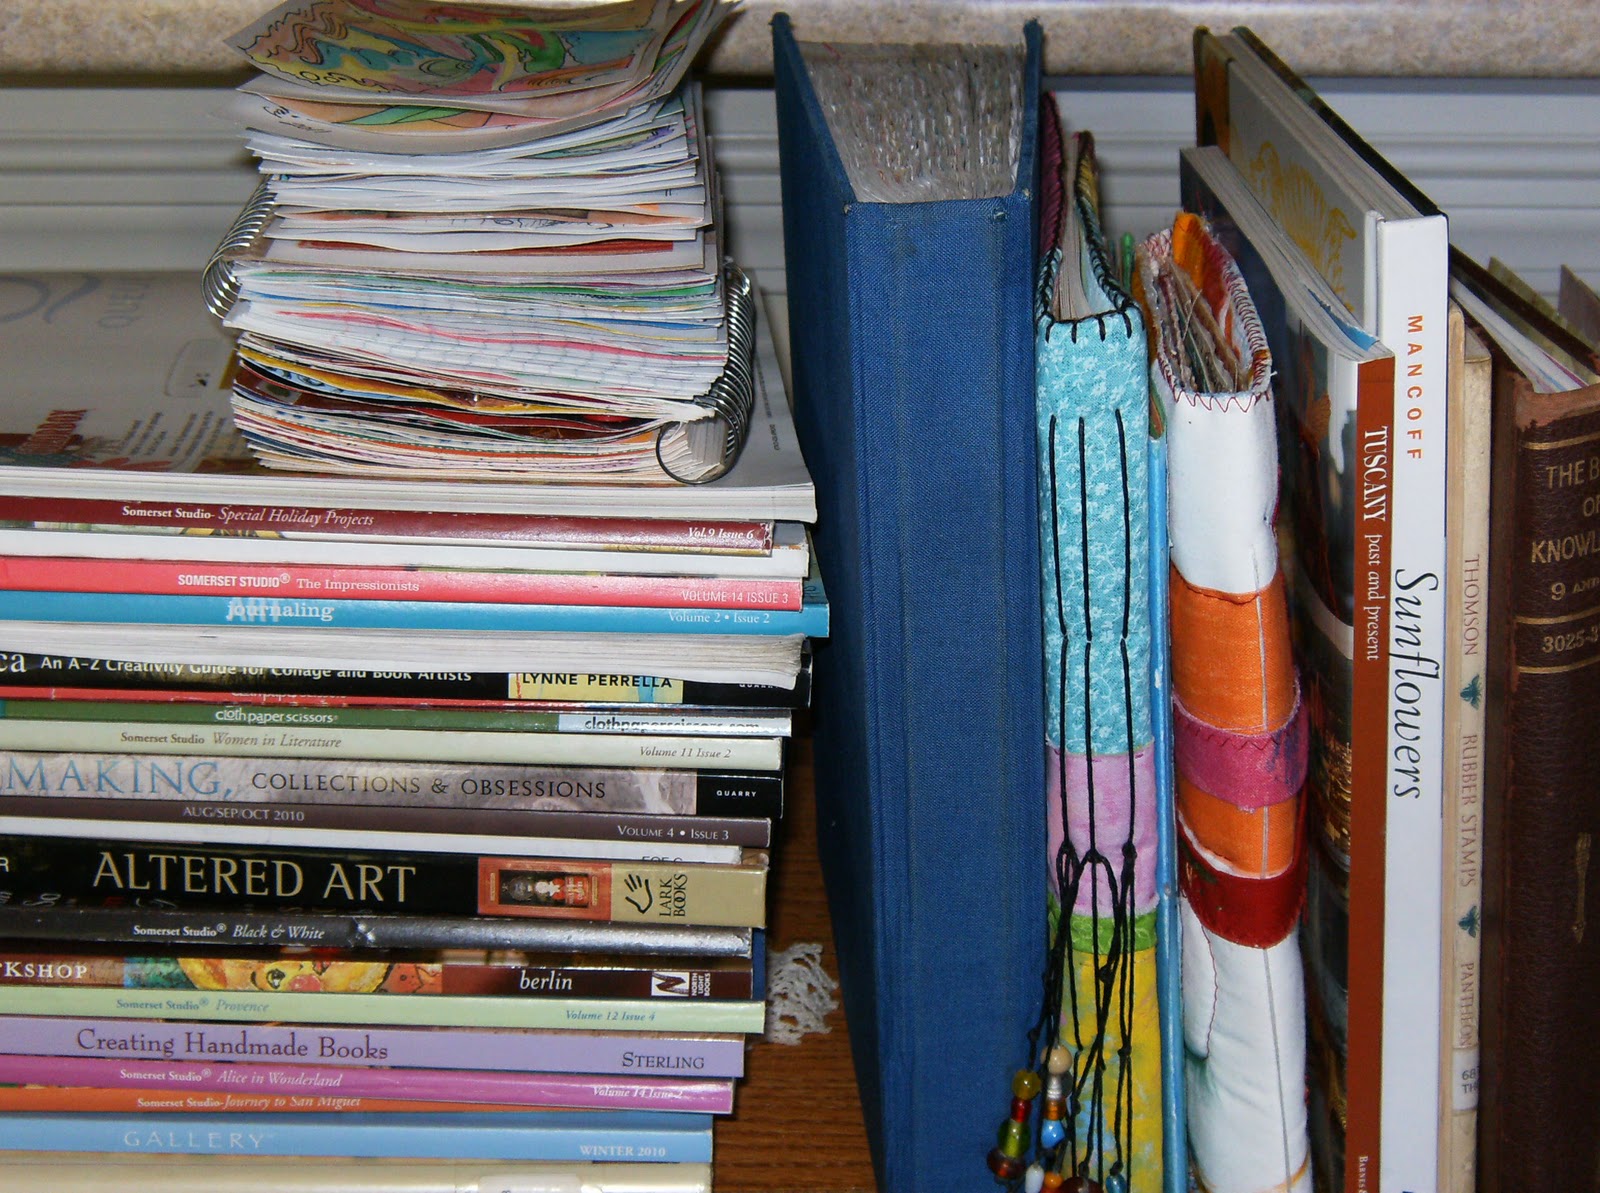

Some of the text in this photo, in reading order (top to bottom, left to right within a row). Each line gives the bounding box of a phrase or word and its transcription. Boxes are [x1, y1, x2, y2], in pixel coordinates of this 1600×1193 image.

[1406, 314, 1424, 460] MANCOFF
[1546, 460, 1586, 490] THE
[122, 505, 172, 519] Somerset
[218, 506, 264, 524] Special
[268, 507, 321, 527] Holiday
[323, 508, 375, 528] Projects
[717, 528, 744, 540] Issue
[745, 528, 755, 540] 6
[1363, 425, 1388, 661] TUSCANY past and present
[178, 574, 237, 588] SOMERSET
[296, 578, 321, 590] The
[324, 579, 419, 594] Impressionists
[1551, 582, 1566, 601] 9
[681, 590, 789, 604] VOLUME 14 ISSUE 3
[1463, 553, 1481, 656] THOMSON
[669, 610, 771, 625] Volume 2 Issue 2
[41, 656, 62, 670] An
[522, 673, 672, 689] LYNNE PERRELLA
[1388, 568, 1441, 800] Sunflowers
[120, 732, 342, 749] Somerset Studio Women in Literature
[639, 746, 732, 760] Volume 11 Issue 2
[6, 756, 606, 799] MAKING, COLLECTIONS & OBSESSIONS
[716, 789, 757, 798] QUARRY
[274, 810, 304, 822] 2010
[1459, 733, 1479, 888] RUBBER STAMPS
[617, 825, 729, 840] VOLUME 4 ISSUE 3
[93, 851, 416, 904] ALTERED ART
[659, 879, 673, 917] LARK
[674, 873, 688, 917] BOOKS
[133, 925, 181, 938] Somerset
[233, 924, 267, 939] Black
[271, 924, 285, 938] &
[288, 925, 325, 940] White
[0, 961, 88, 979] KSHOP
[520, 969, 573, 991] berlin
[116, 999, 163, 1011] Somerset
[216, 999, 270, 1013] Provence
[566, 1009, 656, 1022] Volume 12 Issue 4
[77, 1028, 389, 1061] Creating Handmade Books
[622, 1051, 705, 1069] STERLING
[120, 1069, 167, 1082] Somerset
[217, 1071, 248, 1085] Alice
[251, 1072, 264, 1085] in
[269, 1071, 343, 1089] Wonderland
[593, 1086, 630, 1098] Volume
[137, 1096, 184, 1108] Somerset
[274, 1097, 286, 1107] to
[290, 1095, 314, 1108] San
[124, 1129, 265, 1149] GALLERY
[579, 1144, 666, 1158] WINTER 2010
[1358, 1156, 1368, 1188] BARNES
